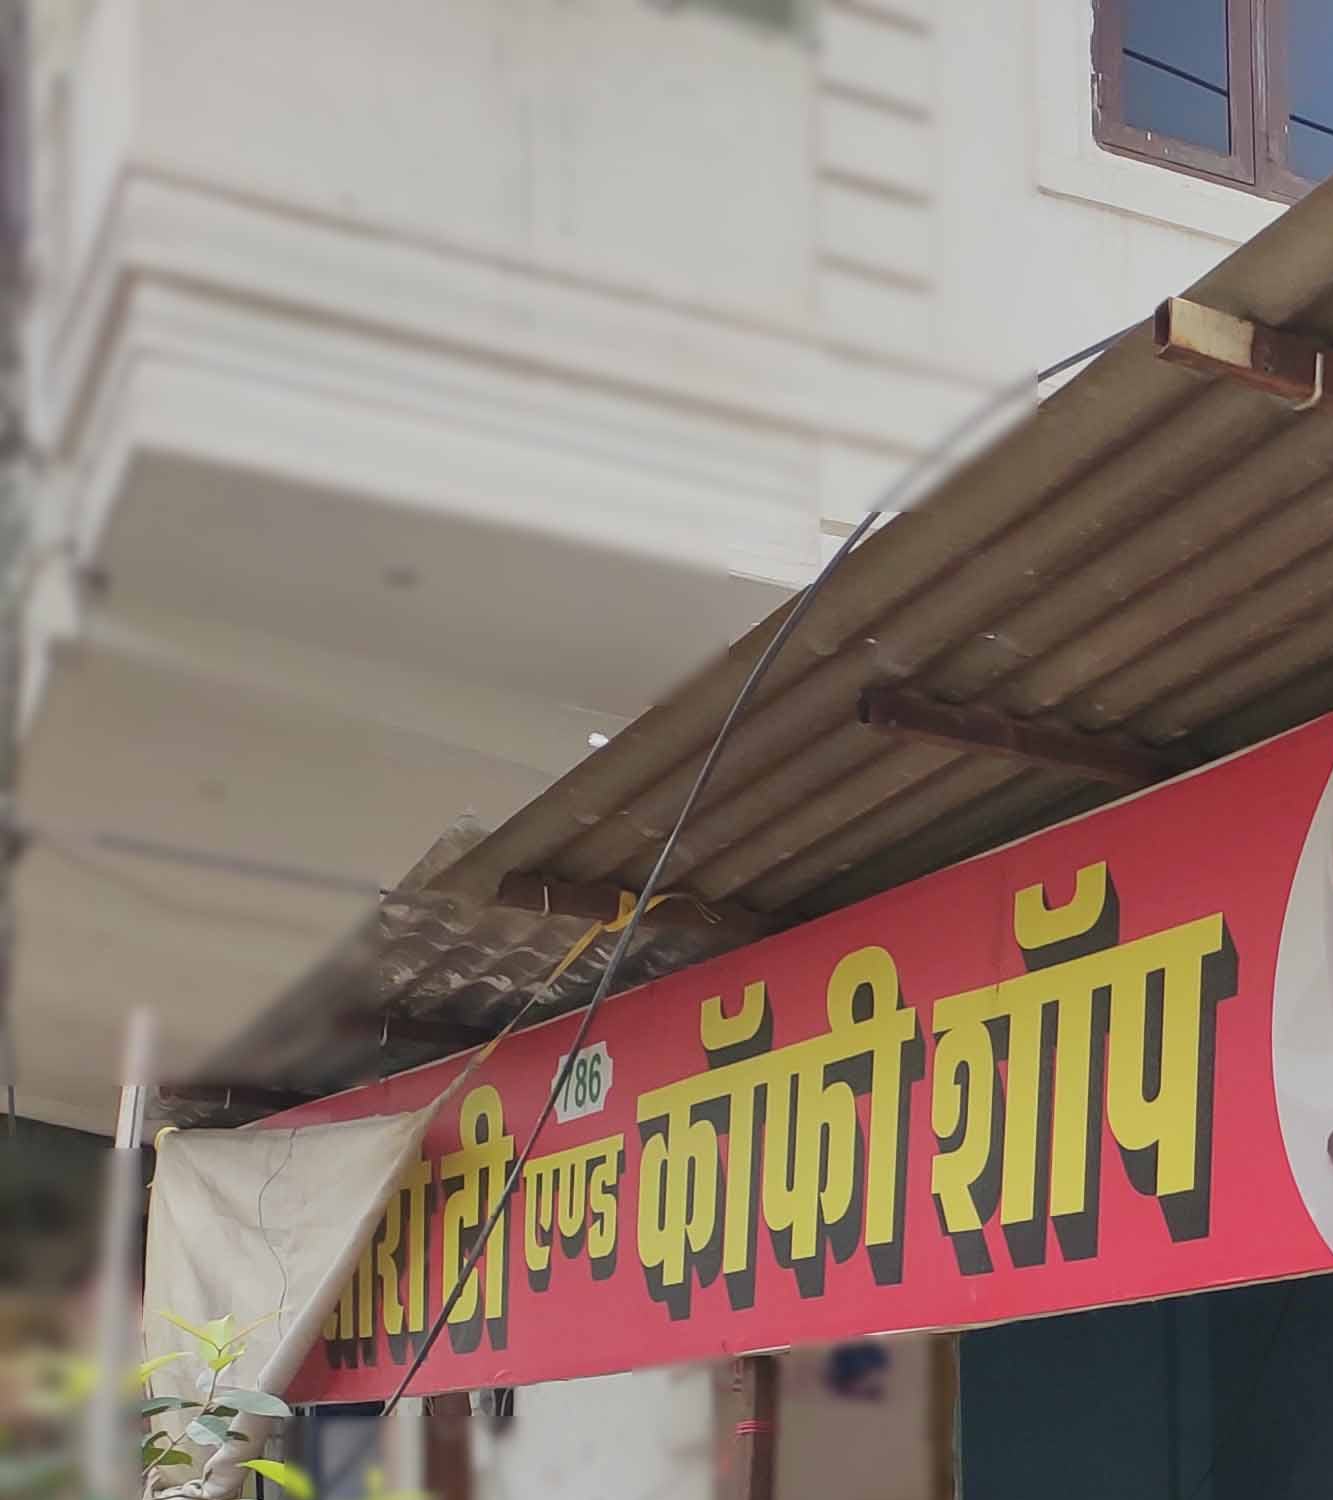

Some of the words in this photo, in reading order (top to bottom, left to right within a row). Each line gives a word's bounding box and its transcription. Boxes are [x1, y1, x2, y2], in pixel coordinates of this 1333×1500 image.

[441, 1085, 514, 1325] टी
[523, 1135, 623, 1270] एण्ड
[637, 946, 916, 1285] कॉफी
[931, 861, 1224, 1234] शॉप
